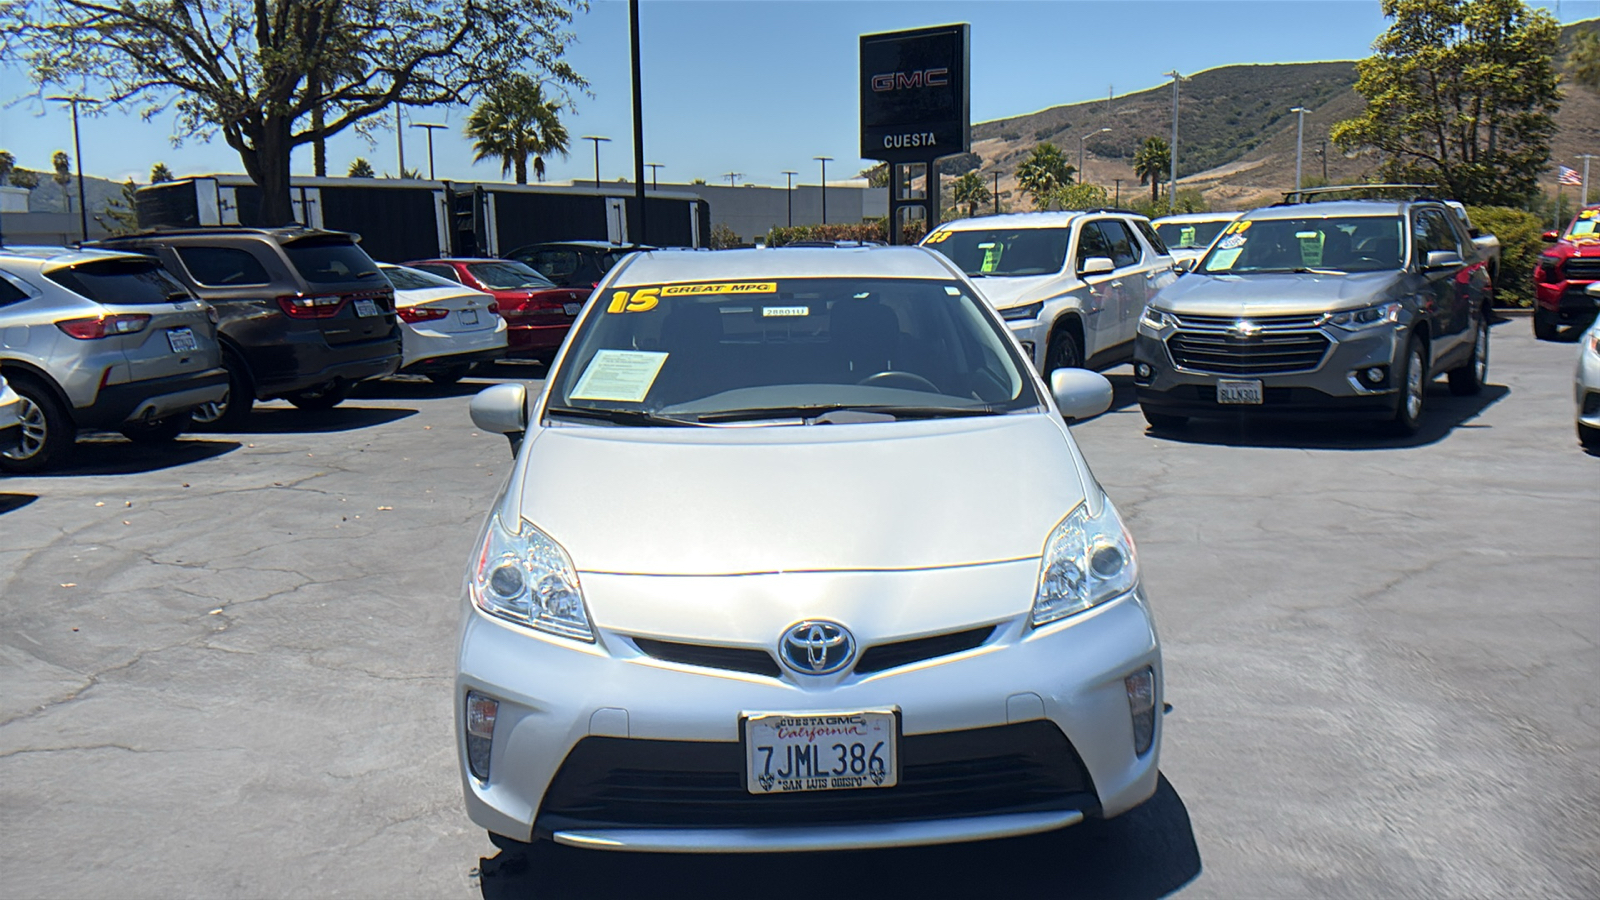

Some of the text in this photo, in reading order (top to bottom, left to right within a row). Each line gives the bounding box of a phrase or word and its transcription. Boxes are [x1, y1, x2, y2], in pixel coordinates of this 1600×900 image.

[871, 68, 948, 92] GMC
[884, 132, 936, 149] CUESTA
[1226, 220, 1253, 235] 19
[666, 284, 769, 294] GREAT MPG
[607, 288, 661, 313] 15
[780, 716, 862, 727] CUESTA GMC
[777, 725, 868, 743] California
[757, 741, 885, 777] 7JML386
[783, 777, 863, 791] SAN LUIS OBISPO
